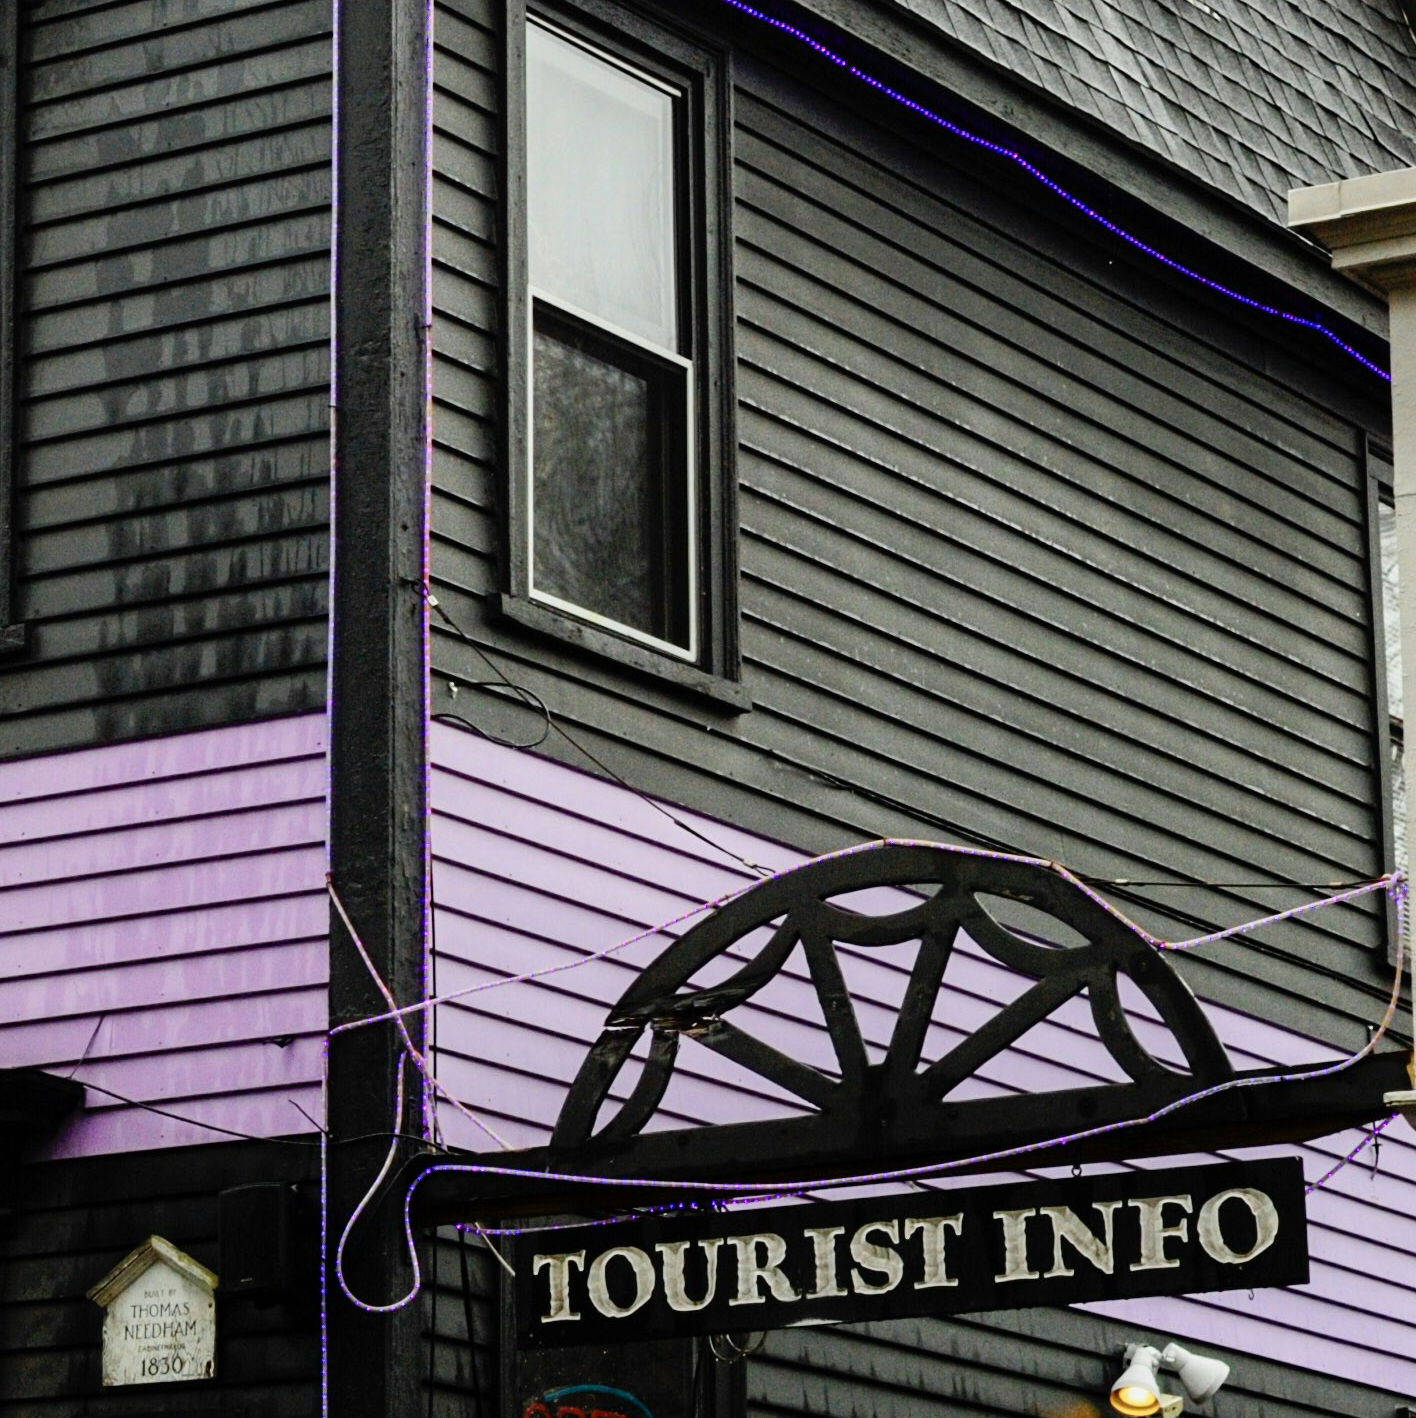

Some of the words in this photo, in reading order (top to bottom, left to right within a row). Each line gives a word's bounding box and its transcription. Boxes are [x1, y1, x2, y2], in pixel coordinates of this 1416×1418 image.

[533, 1212, 964, 1323] TOURIST
[993, 1187, 1280, 1284] INFO
[144, 1289, 165, 1299] BUILT
[168, 1288, 177, 1297] BY
[130, 1302, 190, 1319] THOMAS
[124, 1320, 197, 1341] NEEDHAM
[141, 1356, 184, 1377] 1830
